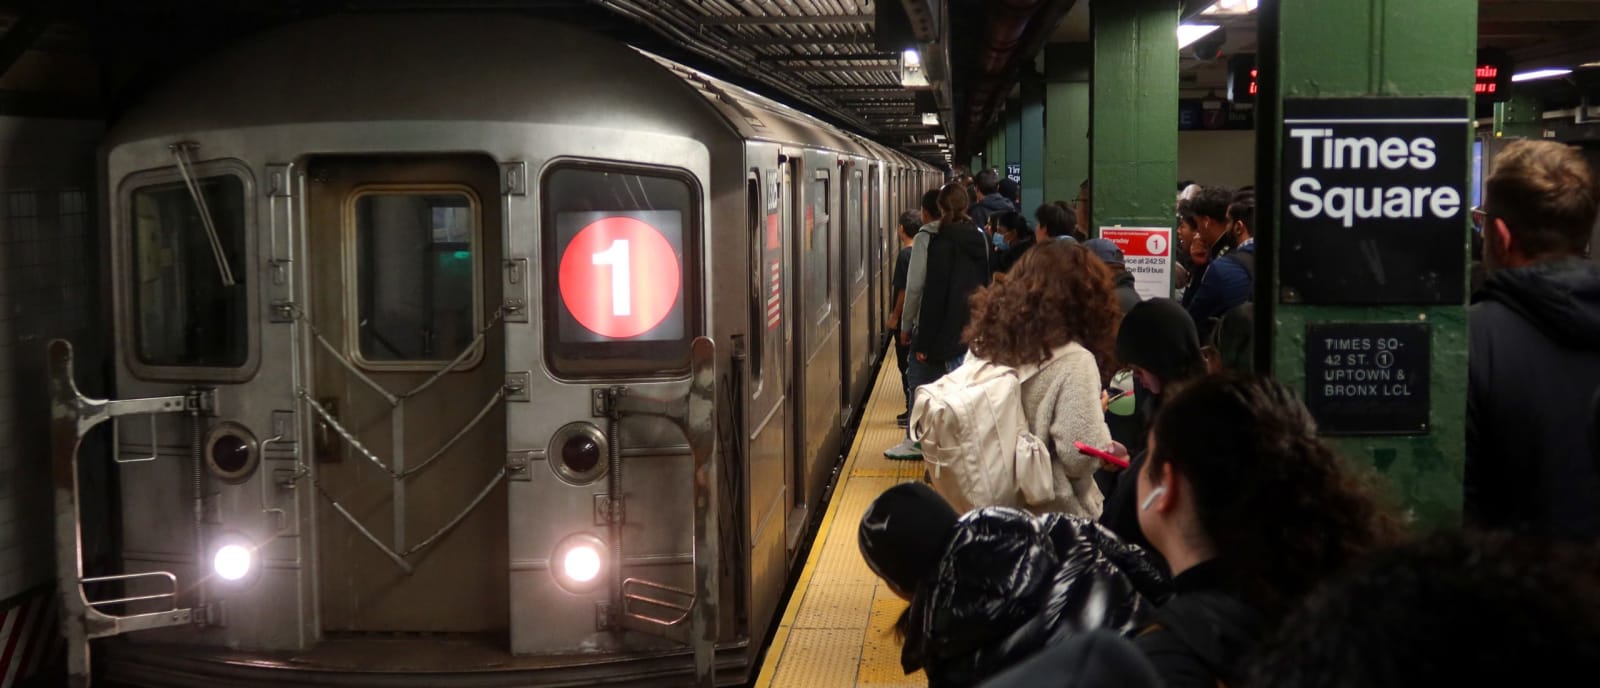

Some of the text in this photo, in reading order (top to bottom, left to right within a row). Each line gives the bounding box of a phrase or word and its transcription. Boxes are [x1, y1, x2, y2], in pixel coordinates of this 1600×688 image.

[1290, 128, 1437, 170] Times
[1289, 177, 1461, 228] Square
[1152, 239, 1159, 250] 1
[1145, 257, 1158, 265] 242
[1159, 257, 1166, 265] St
[592, 239, 631, 316] 1
[1324, 338, 1371, 350] TIMES
[1324, 354, 1342, 366] 42
[1347, 354, 1369, 366] ST.
[1324, 369, 1405, 381] UPTOWN &
[1324, 384, 1412, 396] BRONX LCL
